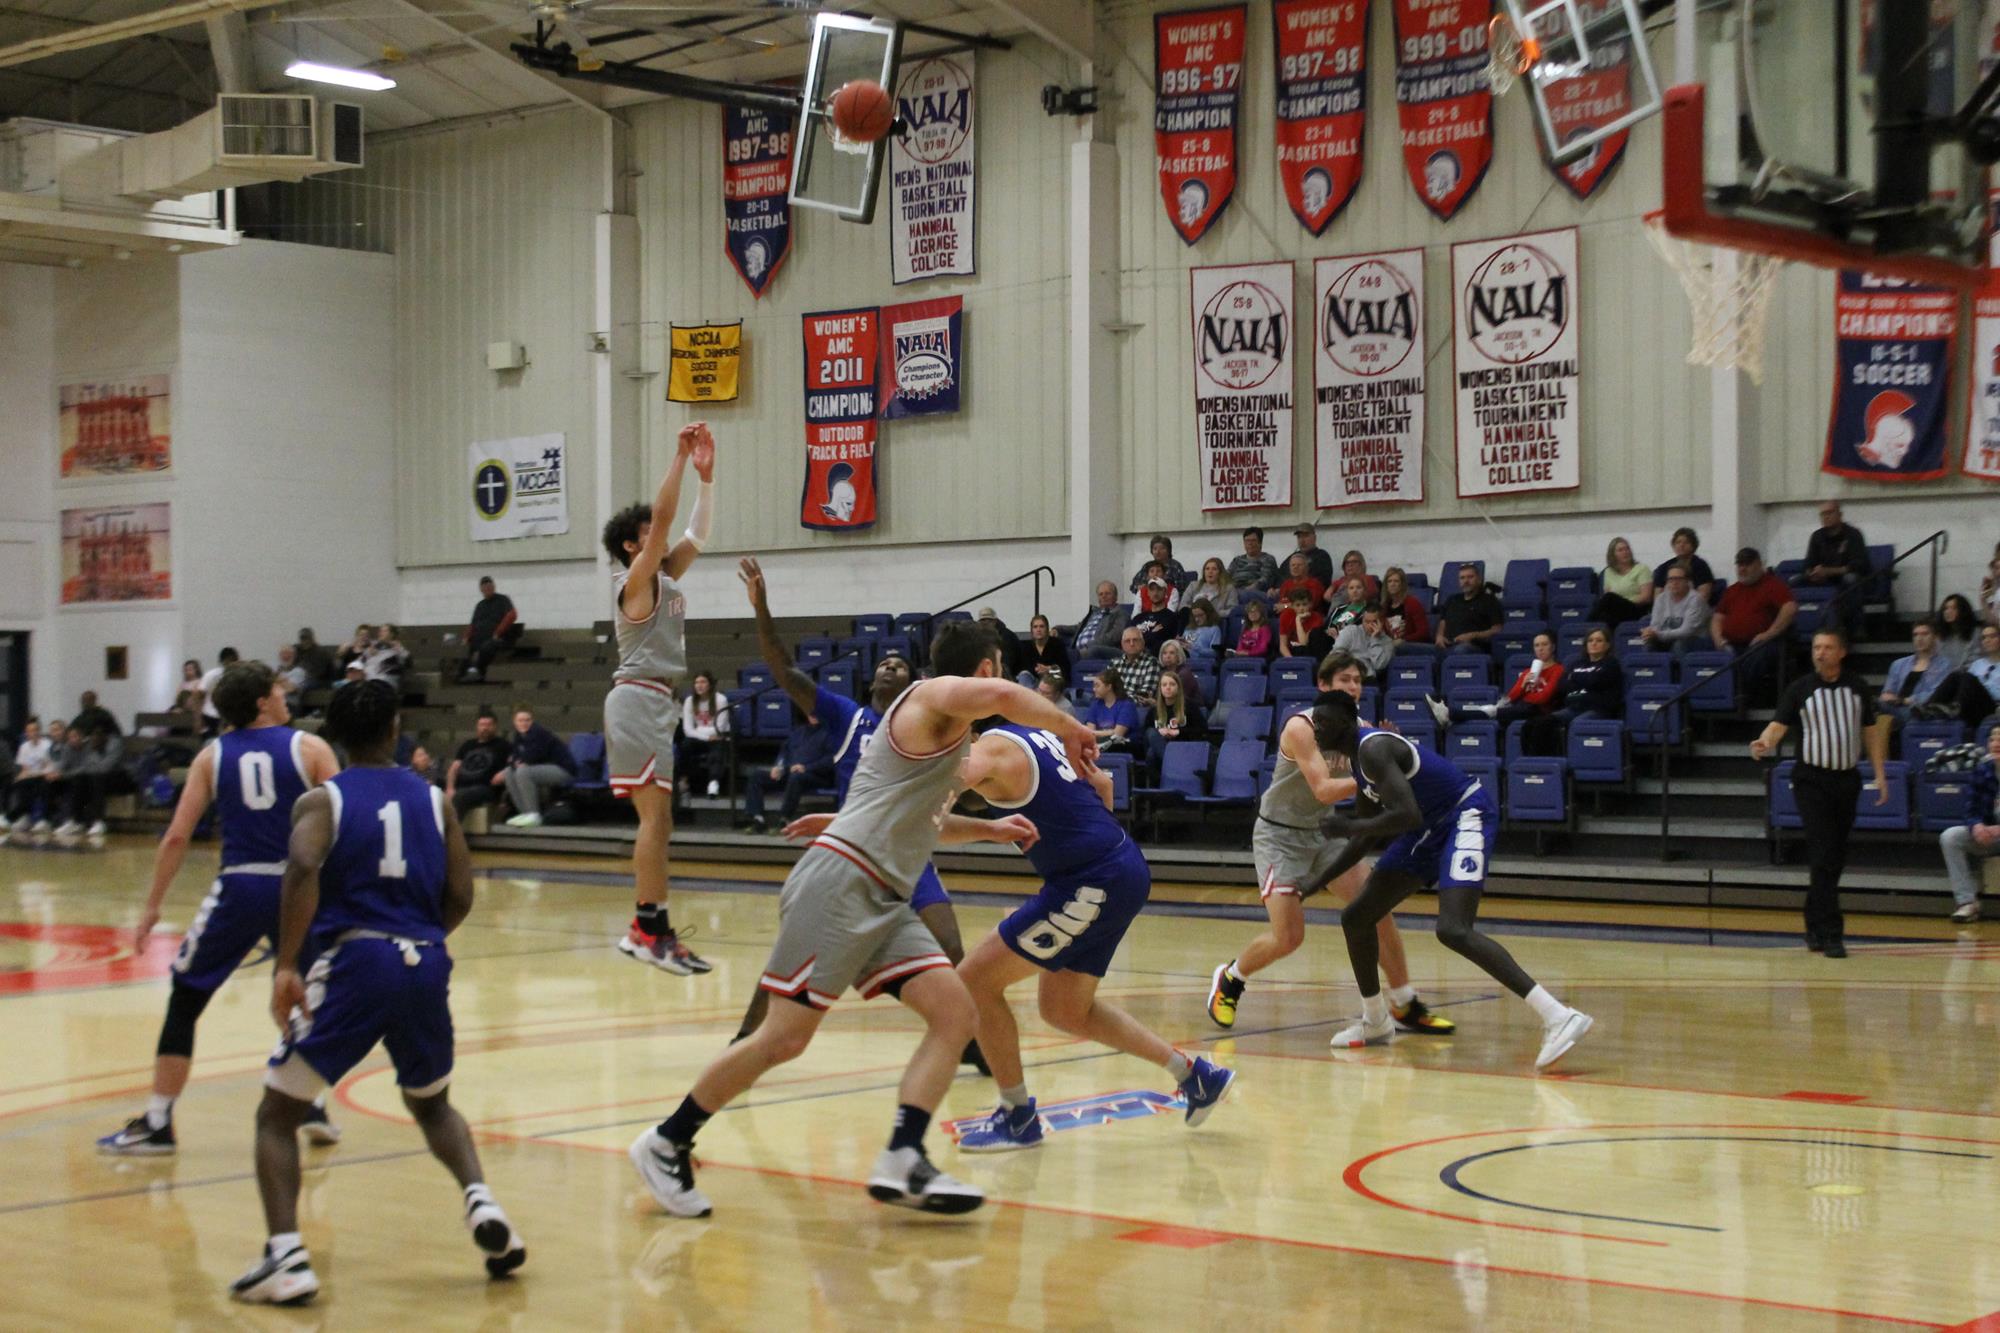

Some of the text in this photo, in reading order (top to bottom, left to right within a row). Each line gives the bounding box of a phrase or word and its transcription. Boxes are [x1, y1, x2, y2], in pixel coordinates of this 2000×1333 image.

[1167, 21, 1232, 46] WOMEN'S
[1305, 26, 1336, 49] AMC
[1185, 43, 1214, 65] AMC
[1397, 70, 1489, 103] CHAMPION
[746, 117, 769, 135] AMC
[898, 87, 972, 145] NAIA
[895, 164, 921, 188] MEN'S
[909, 217, 956, 239] HANNBAL
[908, 234, 958, 257] LAGRNGE
[1469, 275, 1567, 339] NAIA
[814, 316, 868, 337] WOMEN'S
[1326, 292, 1413, 349] NAIA
[1840, 312, 1953, 337] CHAMPIONS
[827, 337, 853, 355] AMC
[896, 331, 947, 362] NAIA
[1202, 313, 1283, 365] NAIA
[820, 357, 863, 384] 2011
[903, 362, 941, 374] Champions
[910, 371, 943, 382] Character
[1852, 362, 1932, 386] SOCCER
[1367, 376, 1424, 400] NATIONAL
[1473, 381, 1567, 409] BASKETBALL
[1197, 392, 1293, 415] OMENS NATIONAL
[1332, 397, 1412, 421] BASKETBALL
[819, 425, 864, 443] OUTDOOR
[1332, 415, 1412, 440] TOURNAMENT
[840, 444, 848, 460] &
[1212, 449, 1268, 469] HANNBAL
[1341, 436, 1402, 460] HANNIBAL
[1340, 455, 1404, 478] LAGRANGE
[1215, 485, 1267, 504] COLLGE
[1345, 474, 1401, 496] COLLEGE
[238, 751, 277, 810] 0
[378, 801, 407, 878] 1
